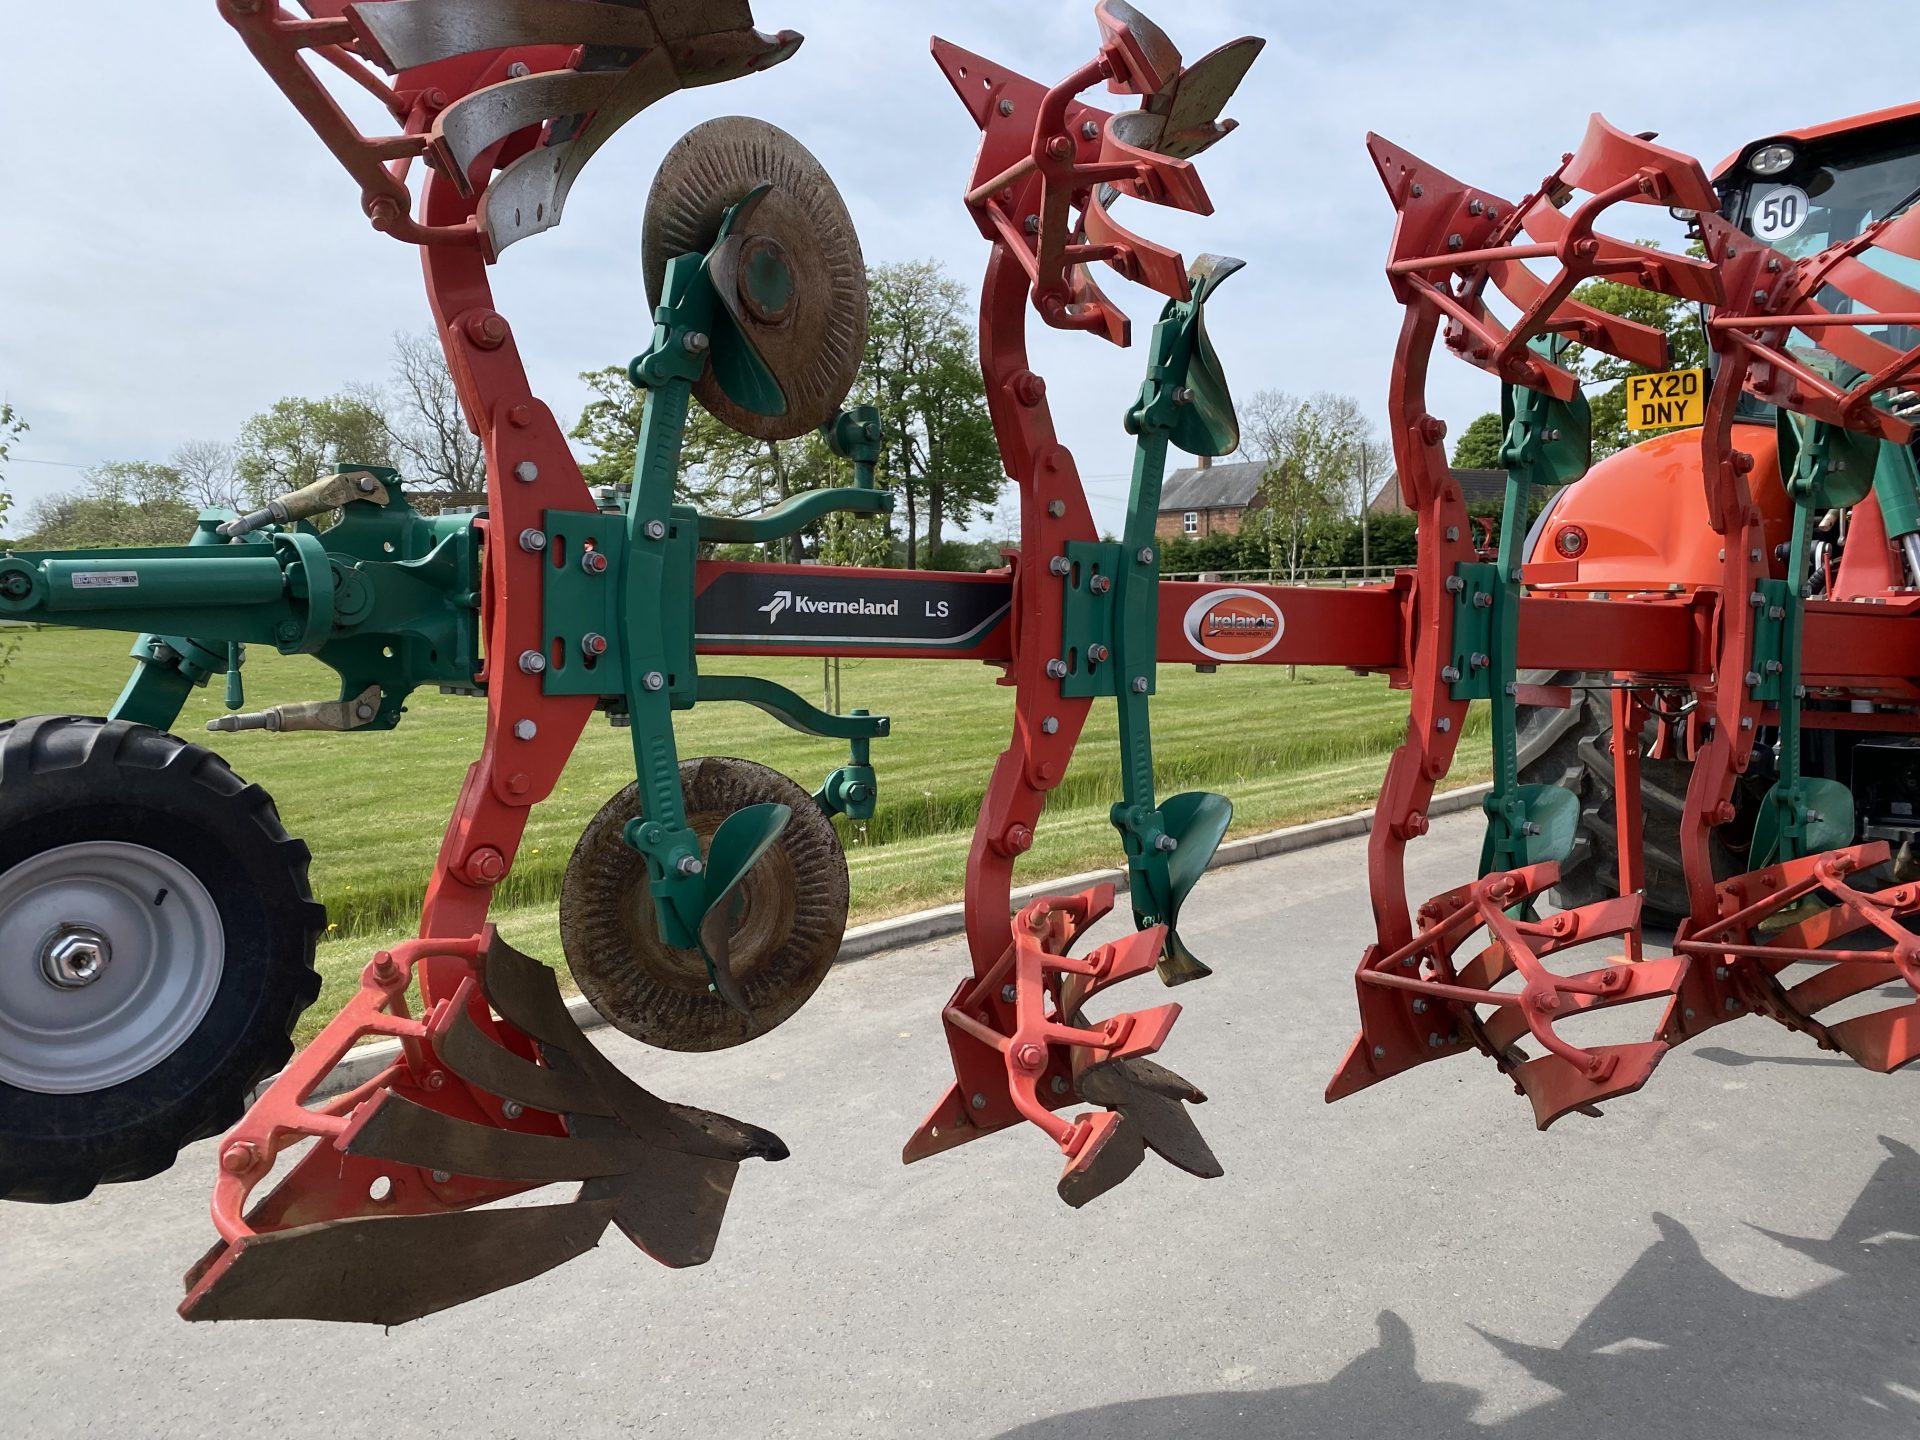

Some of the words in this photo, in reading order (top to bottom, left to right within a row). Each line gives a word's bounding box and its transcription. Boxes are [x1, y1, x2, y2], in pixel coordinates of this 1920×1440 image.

[1763, 195, 1797, 232] 50
[1633, 373, 1697, 401] FX20
[1641, 400, 1688, 425] DNY
[795, 595, 898, 616] Kverneland
[925, 600, 949, 618] LS
[1209, 612, 1275, 630] Irelands
